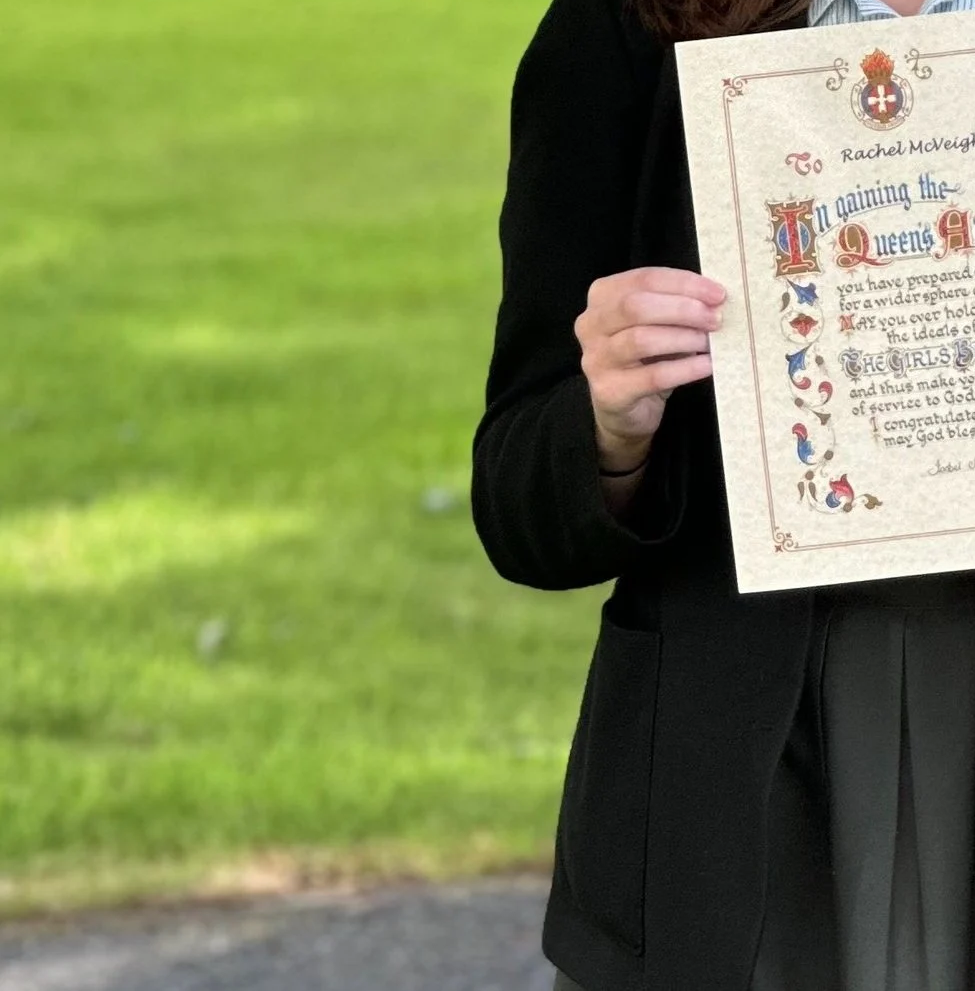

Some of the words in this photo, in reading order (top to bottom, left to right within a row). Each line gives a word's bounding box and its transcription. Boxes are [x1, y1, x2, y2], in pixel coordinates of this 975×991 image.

[841, 141, 904, 163] Rachel
[785, 151, 823, 176] To
[768, 199, 831, 275] In
[835, 180, 911, 220] gaining
[919, 171, 964, 201] the
[837, 280, 864, 297] you
[867, 274, 904, 291] have
[907, 266, 972, 290] prepared
[839, 298, 859, 313] for
[863, 299, 874, 309] a
[874, 292, 920, 306] wider
[923, 287, 970, 305] sphere
[878, 315, 907, 331] you
[886, 329, 910, 345] the
[912, 323, 959, 341] ideals
[849, 386, 878, 399] and
[879, 379, 914, 396] thus
[917, 374, 955, 392] make
[851, 401, 866, 416] of
[868, 398, 921, 414] service
[924, 394, 941, 407] to
[869, 416, 879, 433] I
[883, 433, 913, 448] may
[916, 428, 945, 447] God
